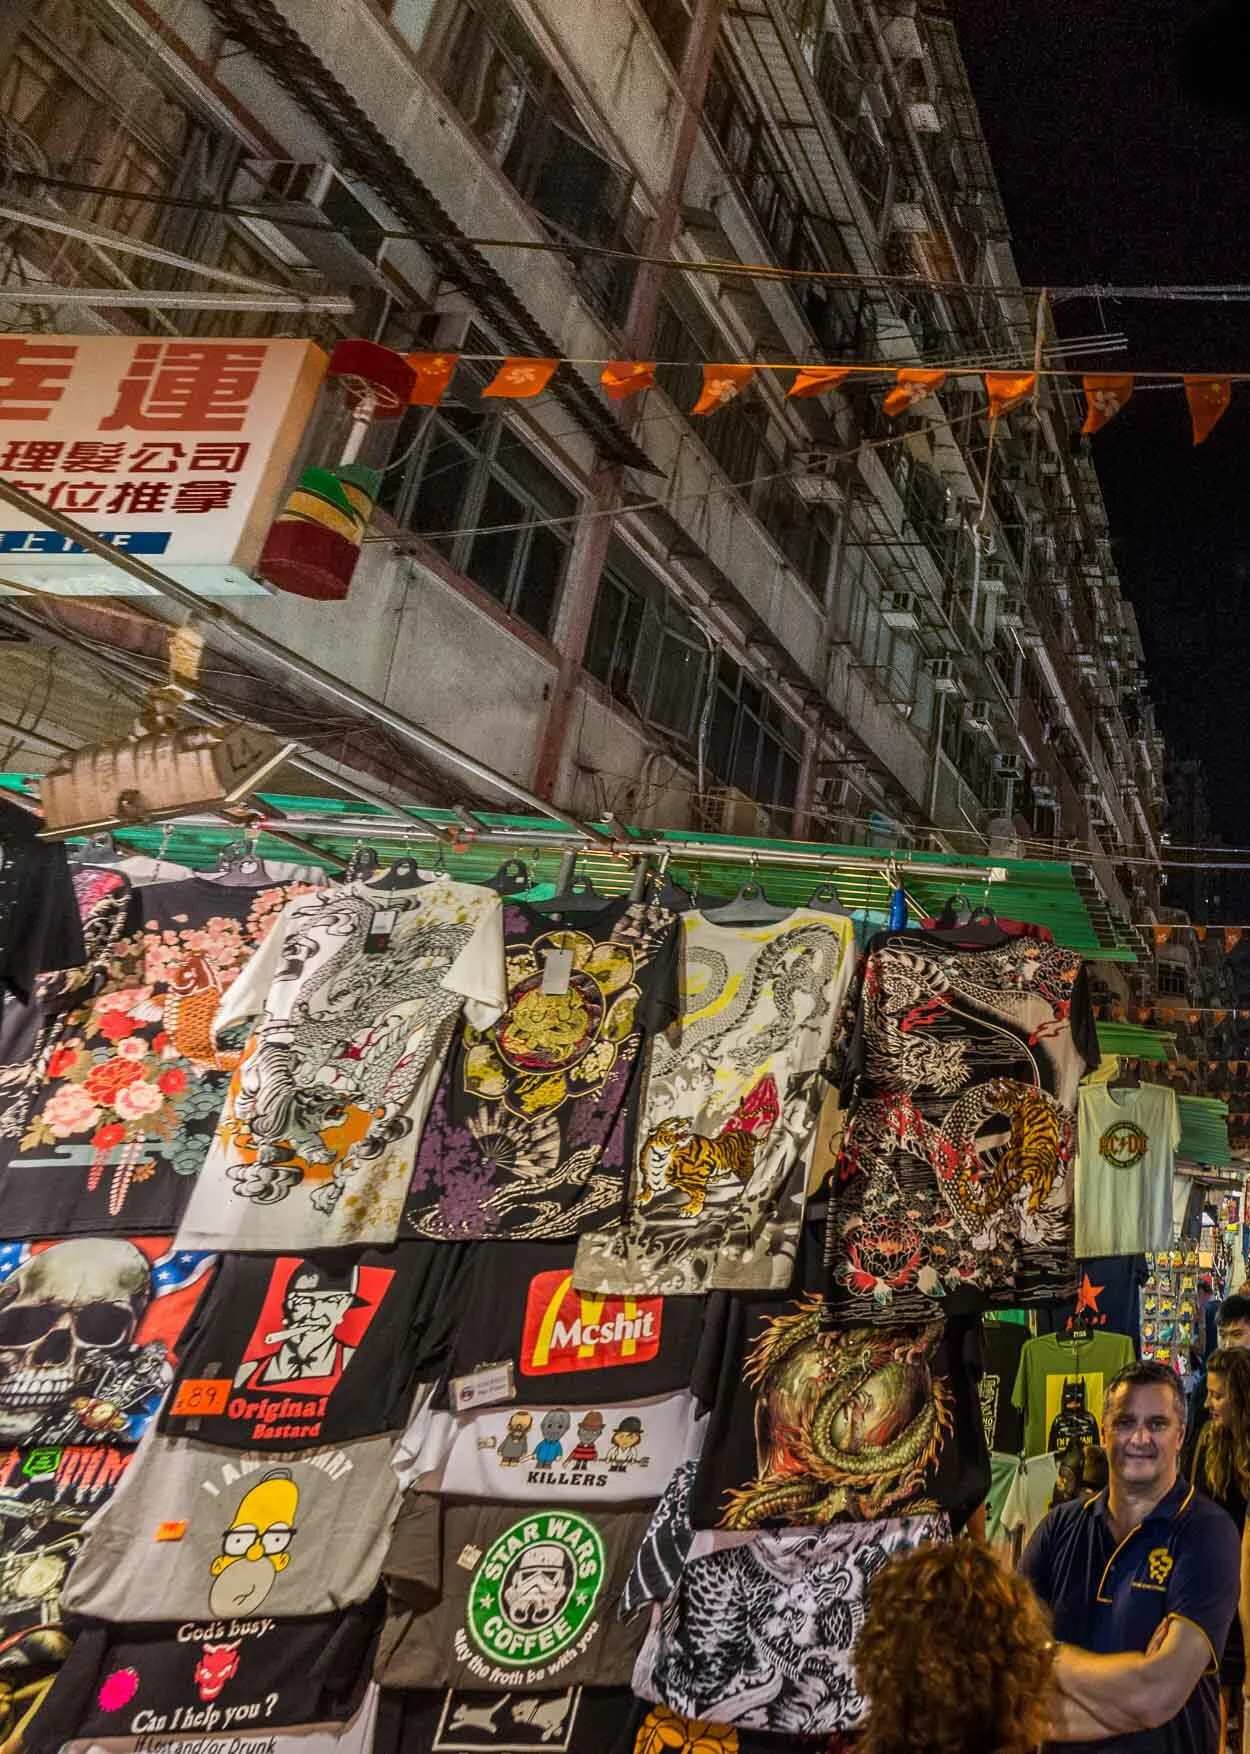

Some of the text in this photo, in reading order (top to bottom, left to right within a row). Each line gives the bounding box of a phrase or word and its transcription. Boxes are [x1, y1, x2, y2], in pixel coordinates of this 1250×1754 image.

[0, 441, 250, 473] 理髮公司
[550, 1309, 654, 1349] Mcshit
[228, 1397, 328, 1424] Original
[252, 1422, 322, 1440] Bastard
[202, 1480, 220, 1497] I
[527, 1471, 608, 1487] KILLERS
[484, 1517, 598, 1581] STAR WARS
[177, 1618, 276, 1642] God's busy.
[483, 1615, 573, 1656] COFFEE
[131, 1710, 168, 1734] Can
[169, 1707, 184, 1730] I
[181, 1703, 221, 1732] help
[175, 1737, 227, 1754] and/or
[229, 1736, 278, 1754] Drunk
